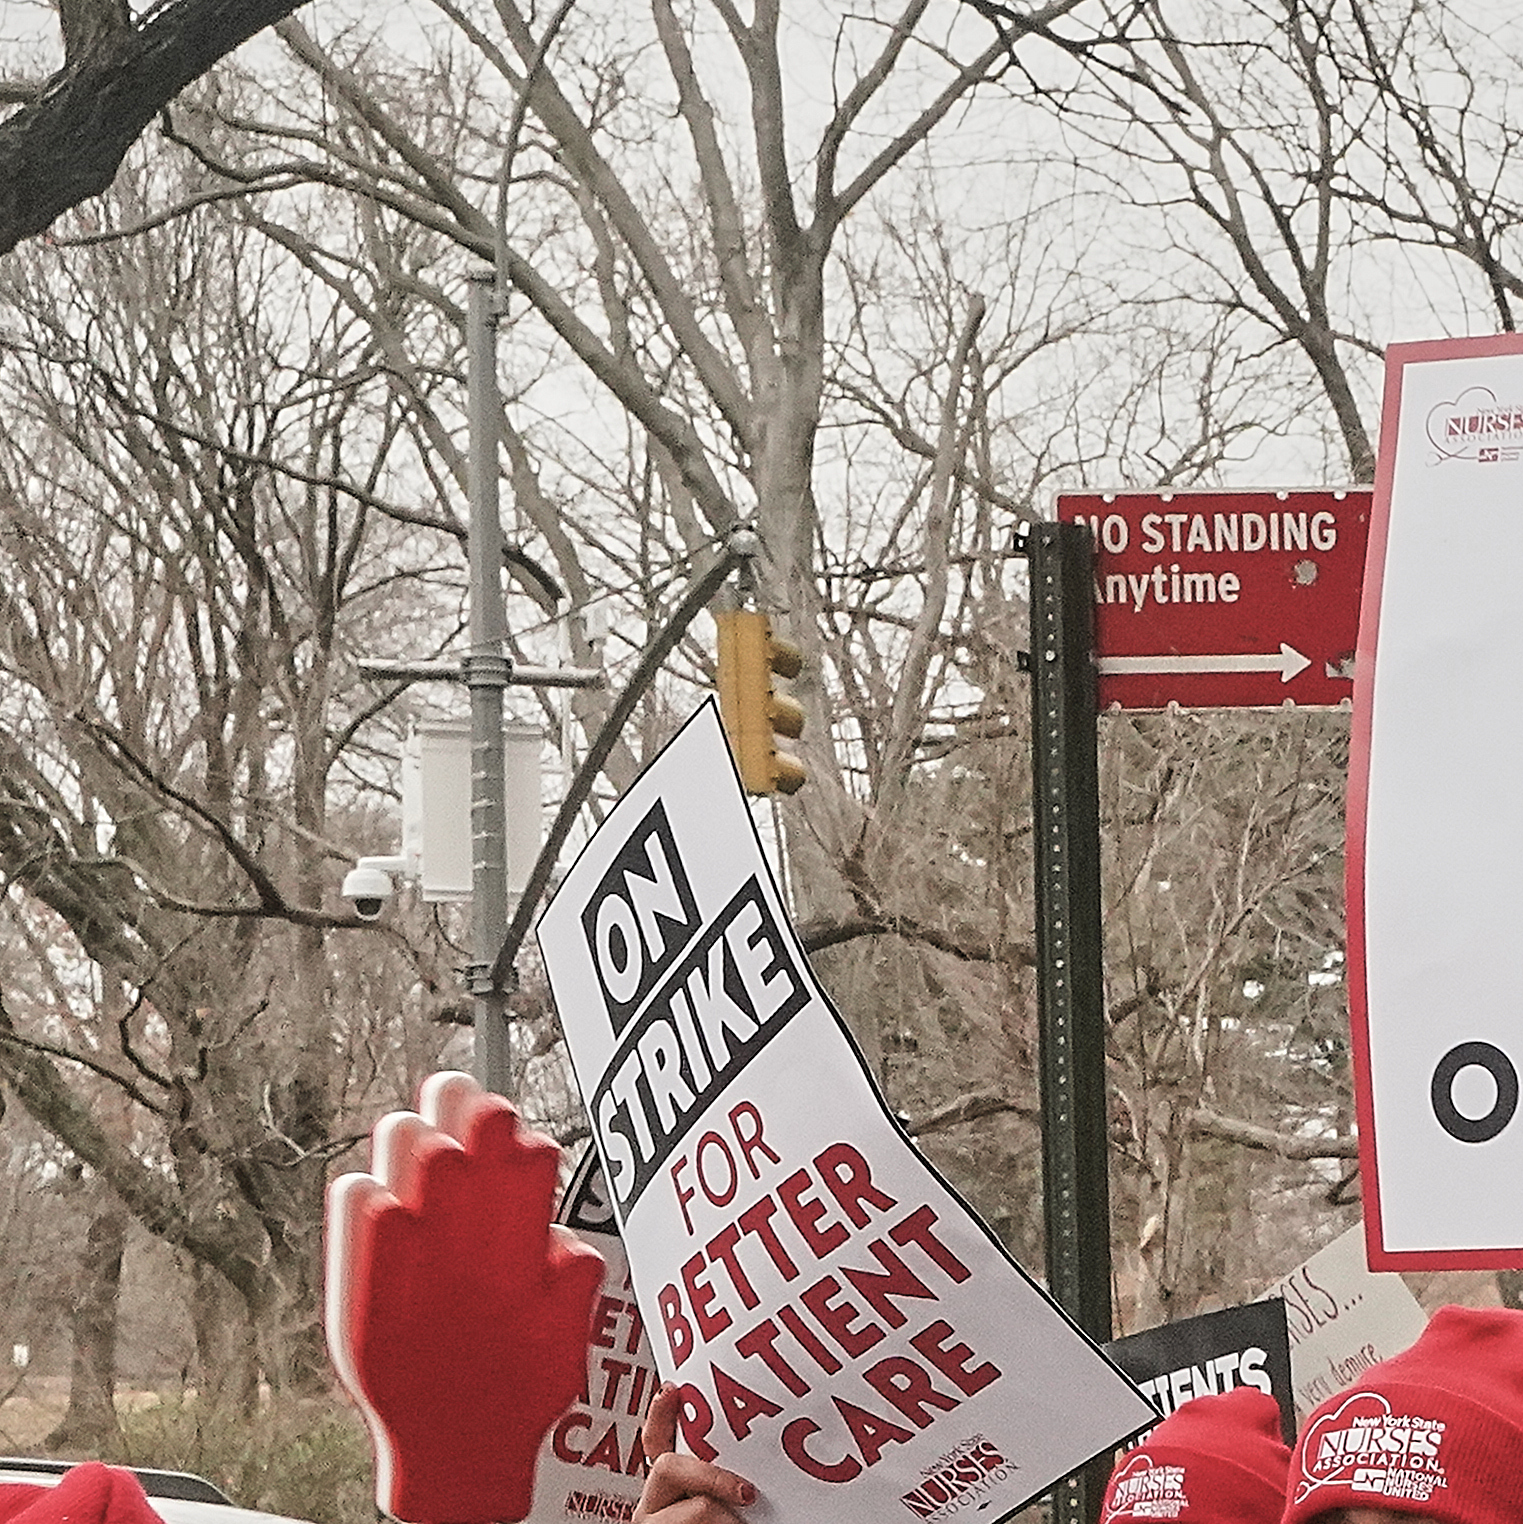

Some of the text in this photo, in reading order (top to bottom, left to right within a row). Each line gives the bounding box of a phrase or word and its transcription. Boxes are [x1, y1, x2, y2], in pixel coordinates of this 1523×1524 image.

[1141, 511, 1337, 552] STANDING
[596, 830, 688, 1003] ON
[600, 899, 795, 1203] STRIKE
[670, 1100, 781, 1236] FOR
[658, 1143, 898, 1370] BETTER
[677, 1204, 972, 1463] PATIENT
[781, 1319, 1002, 1484] CARE
[1317, 1427, 1442, 1459] NURSES
[1353, 1414, 1446, 1432] New York State
[900, 1440, 1004, 1520] NURSES
[1383, 1486, 1429, 1501] UNITED
[1387, 1466, 1448, 1488] NATIONAL
